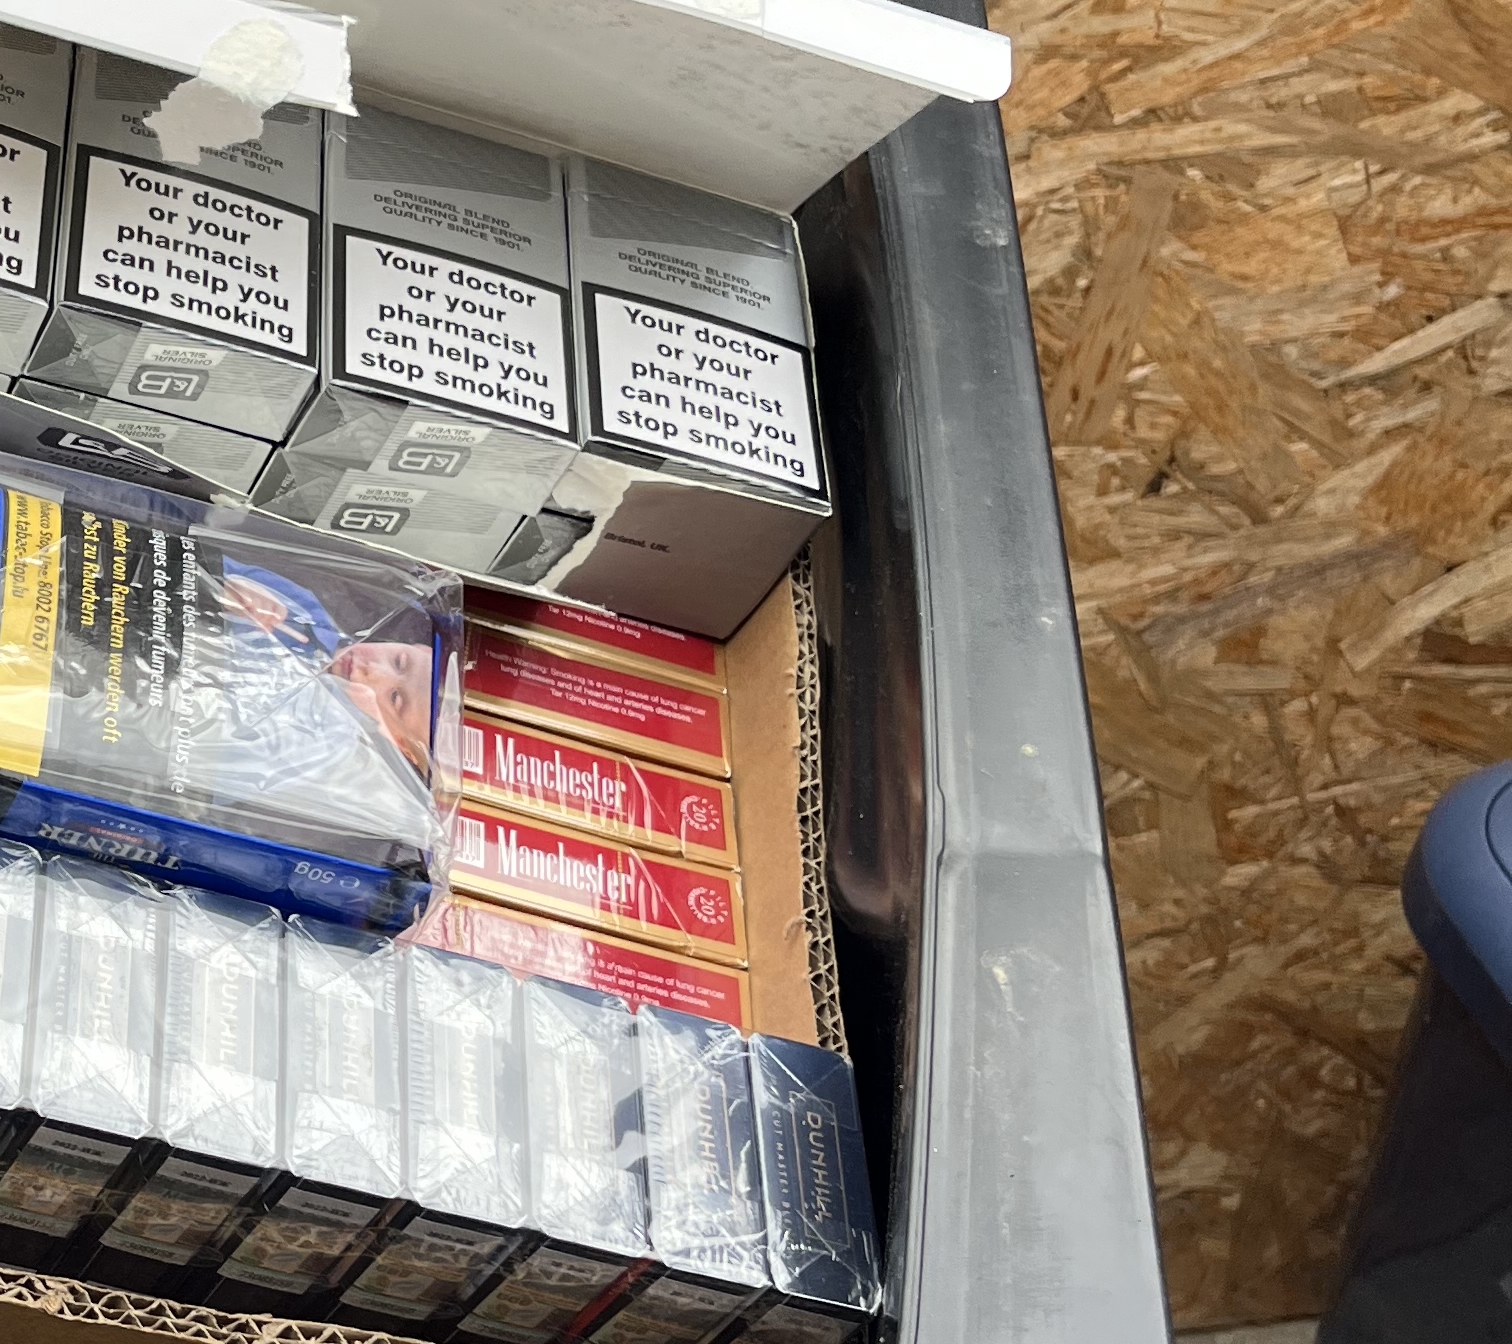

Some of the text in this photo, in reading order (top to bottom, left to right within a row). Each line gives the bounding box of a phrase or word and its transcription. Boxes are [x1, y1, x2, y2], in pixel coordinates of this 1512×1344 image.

[119, 168, 283, 231] Your doctor
[149, 206, 250, 245] or your
[118, 225, 279, 282] pharmacist
[376, 248, 536, 307] Your doctor
[103, 248, 289, 312] can help you
[407, 285, 506, 323] or your
[95, 272, 293, 343] stop smoking
[379, 304, 536, 359] pharmacist
[366, 327, 548, 388] can help you
[624, 306, 779, 366] Your doctor
[137, 370, 199, 396] L&B
[361, 351, 554, 420] stop smoking
[657, 343, 752, 381] or your
[631, 361, 783, 417] pharmacist
[621, 385, 796, 446] can help you
[398, 447, 461, 473] L&B
[617, 409, 805, 478] stop smoking
[340, 508, 400, 533] L&B
[80, 543, 101, 626] zu Rauchern
[112, 556, 124, 580] von
[182, 553, 199, 601] enfants
[35, 581, 53, 613] 8002
[110, 584, 131, 648] Rauchern
[182, 605, 201, 628] des
[32, 616, 49, 651] 6767
[148, 570, 172, 707] de devenir fumeurs
[106, 652, 125, 712] werden
[500, 664, 623, 704] lung and heart and
[550, 668, 678, 710] Smoking main lung
[103, 717, 121, 743] oft
[174, 727, 195, 764] plus
[495, 734, 626, 807] Manchester
[692, 804, 706, 823] 20
[38, 823, 180, 870] TURNER
[293, 861, 336, 883] 50g
[496, 826, 632, 903] Manchester
[699, 895, 715, 914] 20
[806, 1111, 833, 1224] DUNHILL
